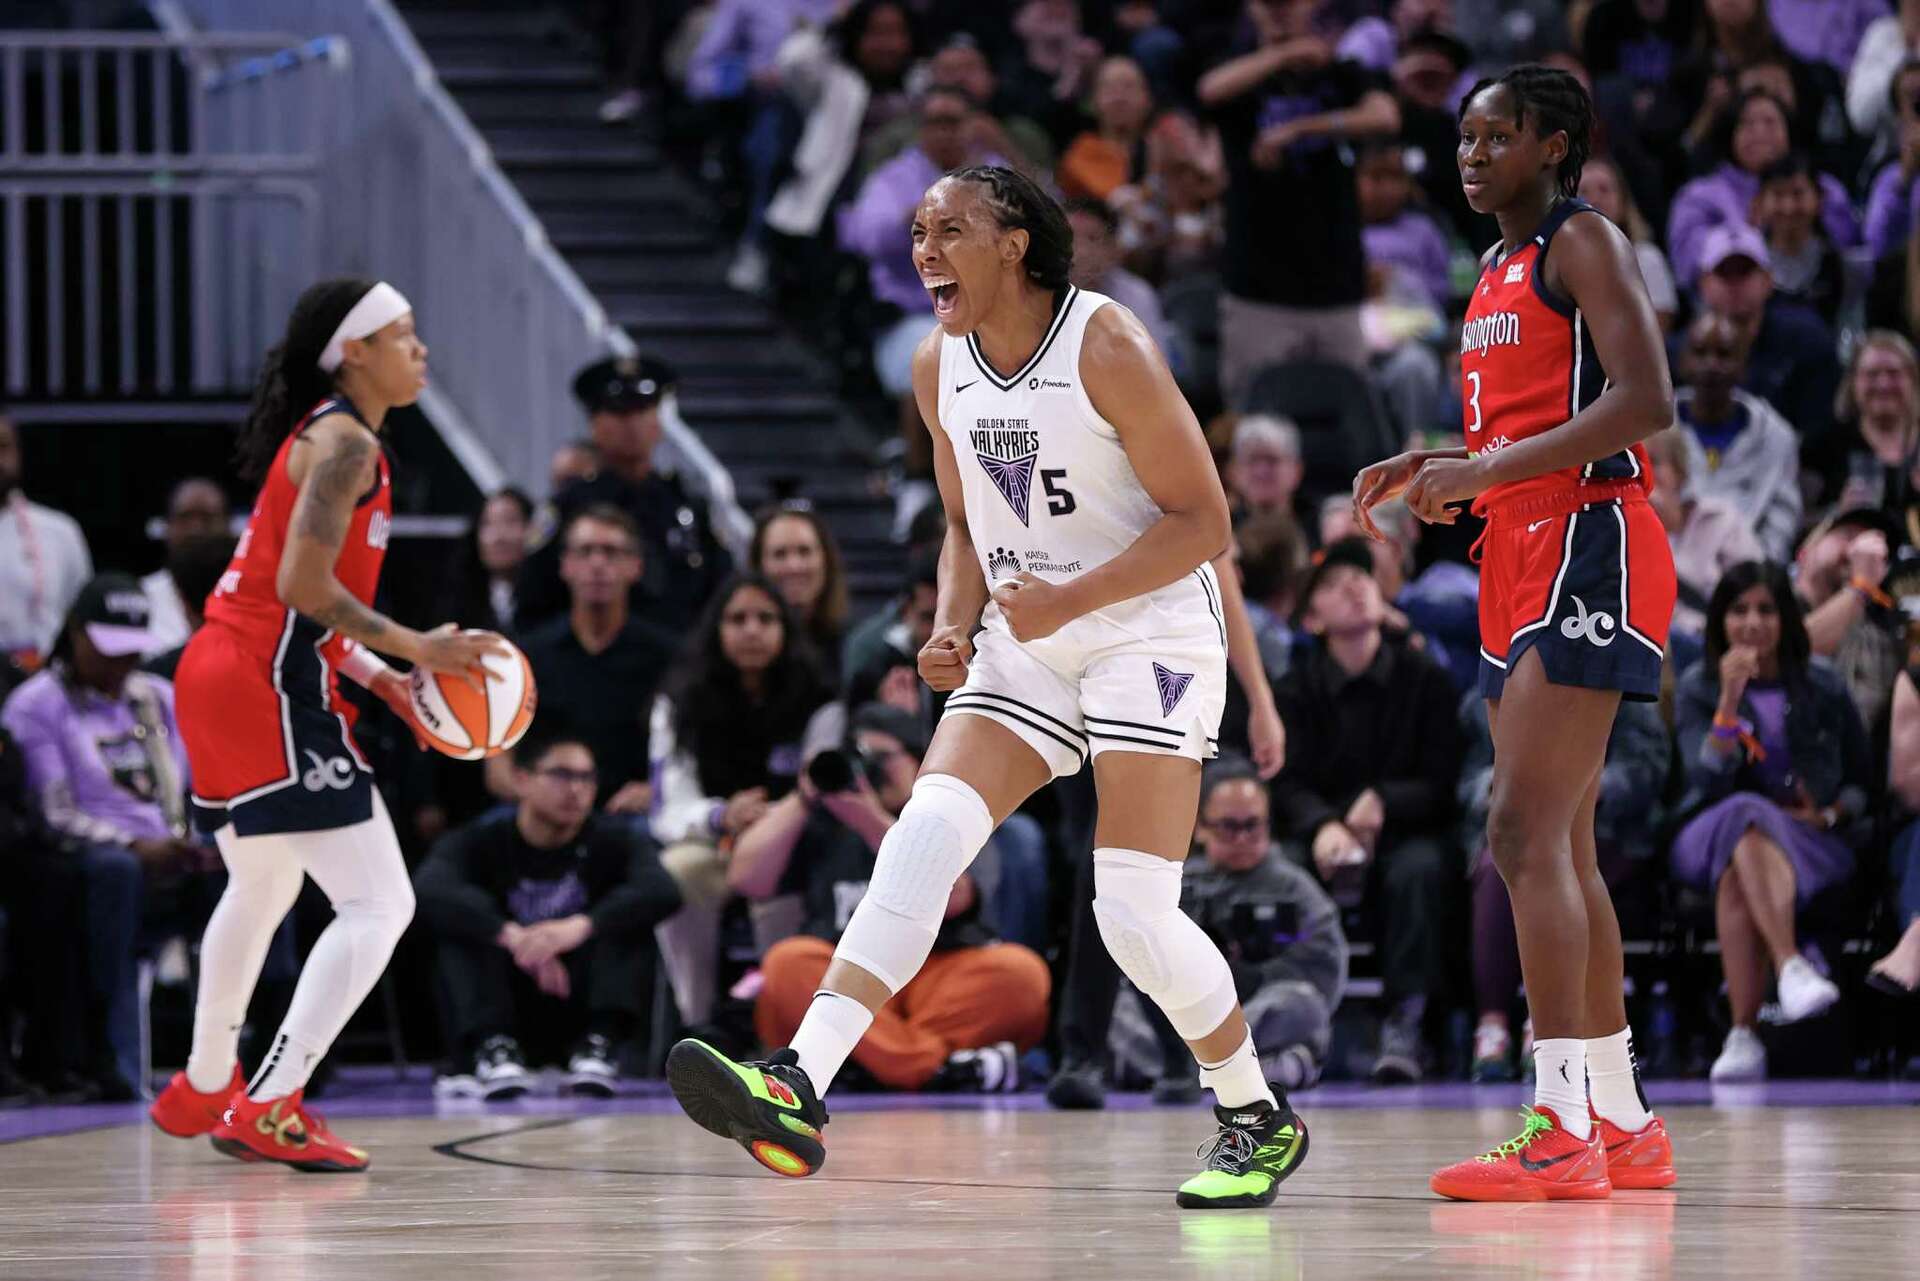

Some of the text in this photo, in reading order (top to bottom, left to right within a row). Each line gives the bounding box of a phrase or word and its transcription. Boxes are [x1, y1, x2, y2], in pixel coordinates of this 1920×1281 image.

[1040, 378, 1071, 389] freedom
[1467, 371, 1482, 432] 3
[976, 418, 1029, 430] GOLDEN STATE
[969, 430, 1039, 460] VALKYRIES
[1040, 469, 1077, 517] 5
